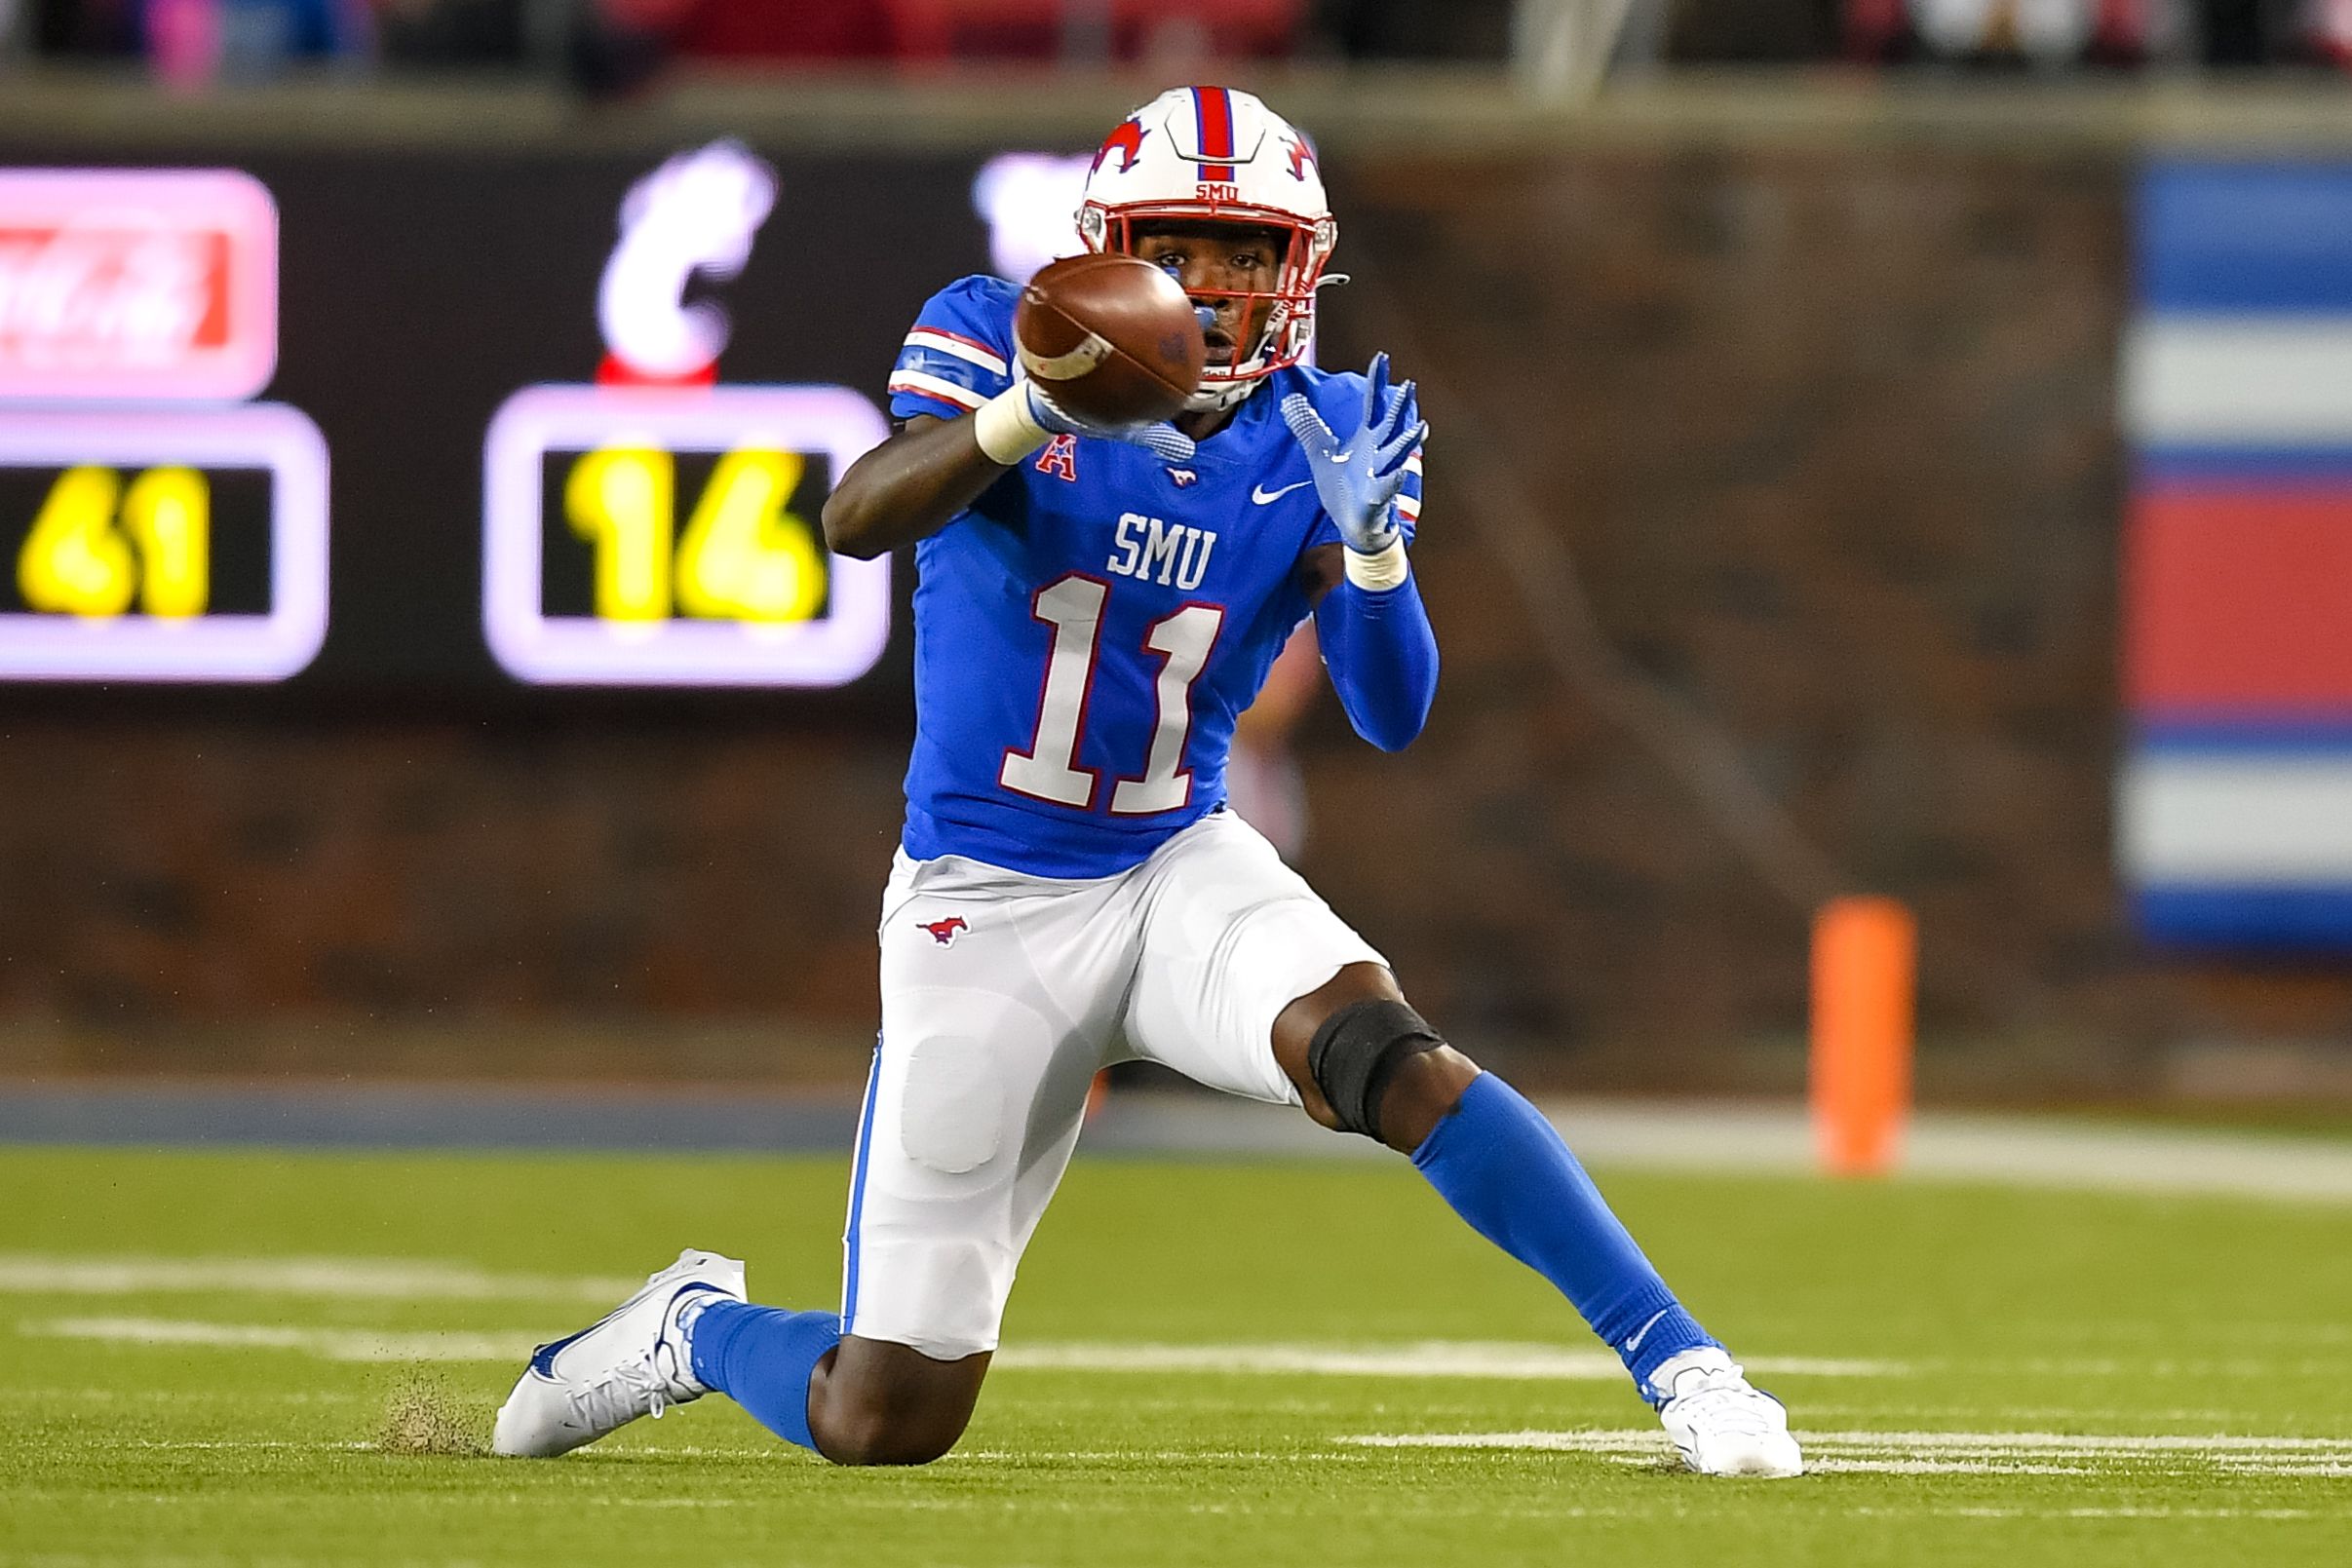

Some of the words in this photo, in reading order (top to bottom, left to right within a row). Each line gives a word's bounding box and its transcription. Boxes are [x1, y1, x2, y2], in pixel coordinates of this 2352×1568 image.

[1195, 183, 1239, 201] SMU
[1106, 512, 1217, 591] SMU
[999, 569, 1225, 819] 11
